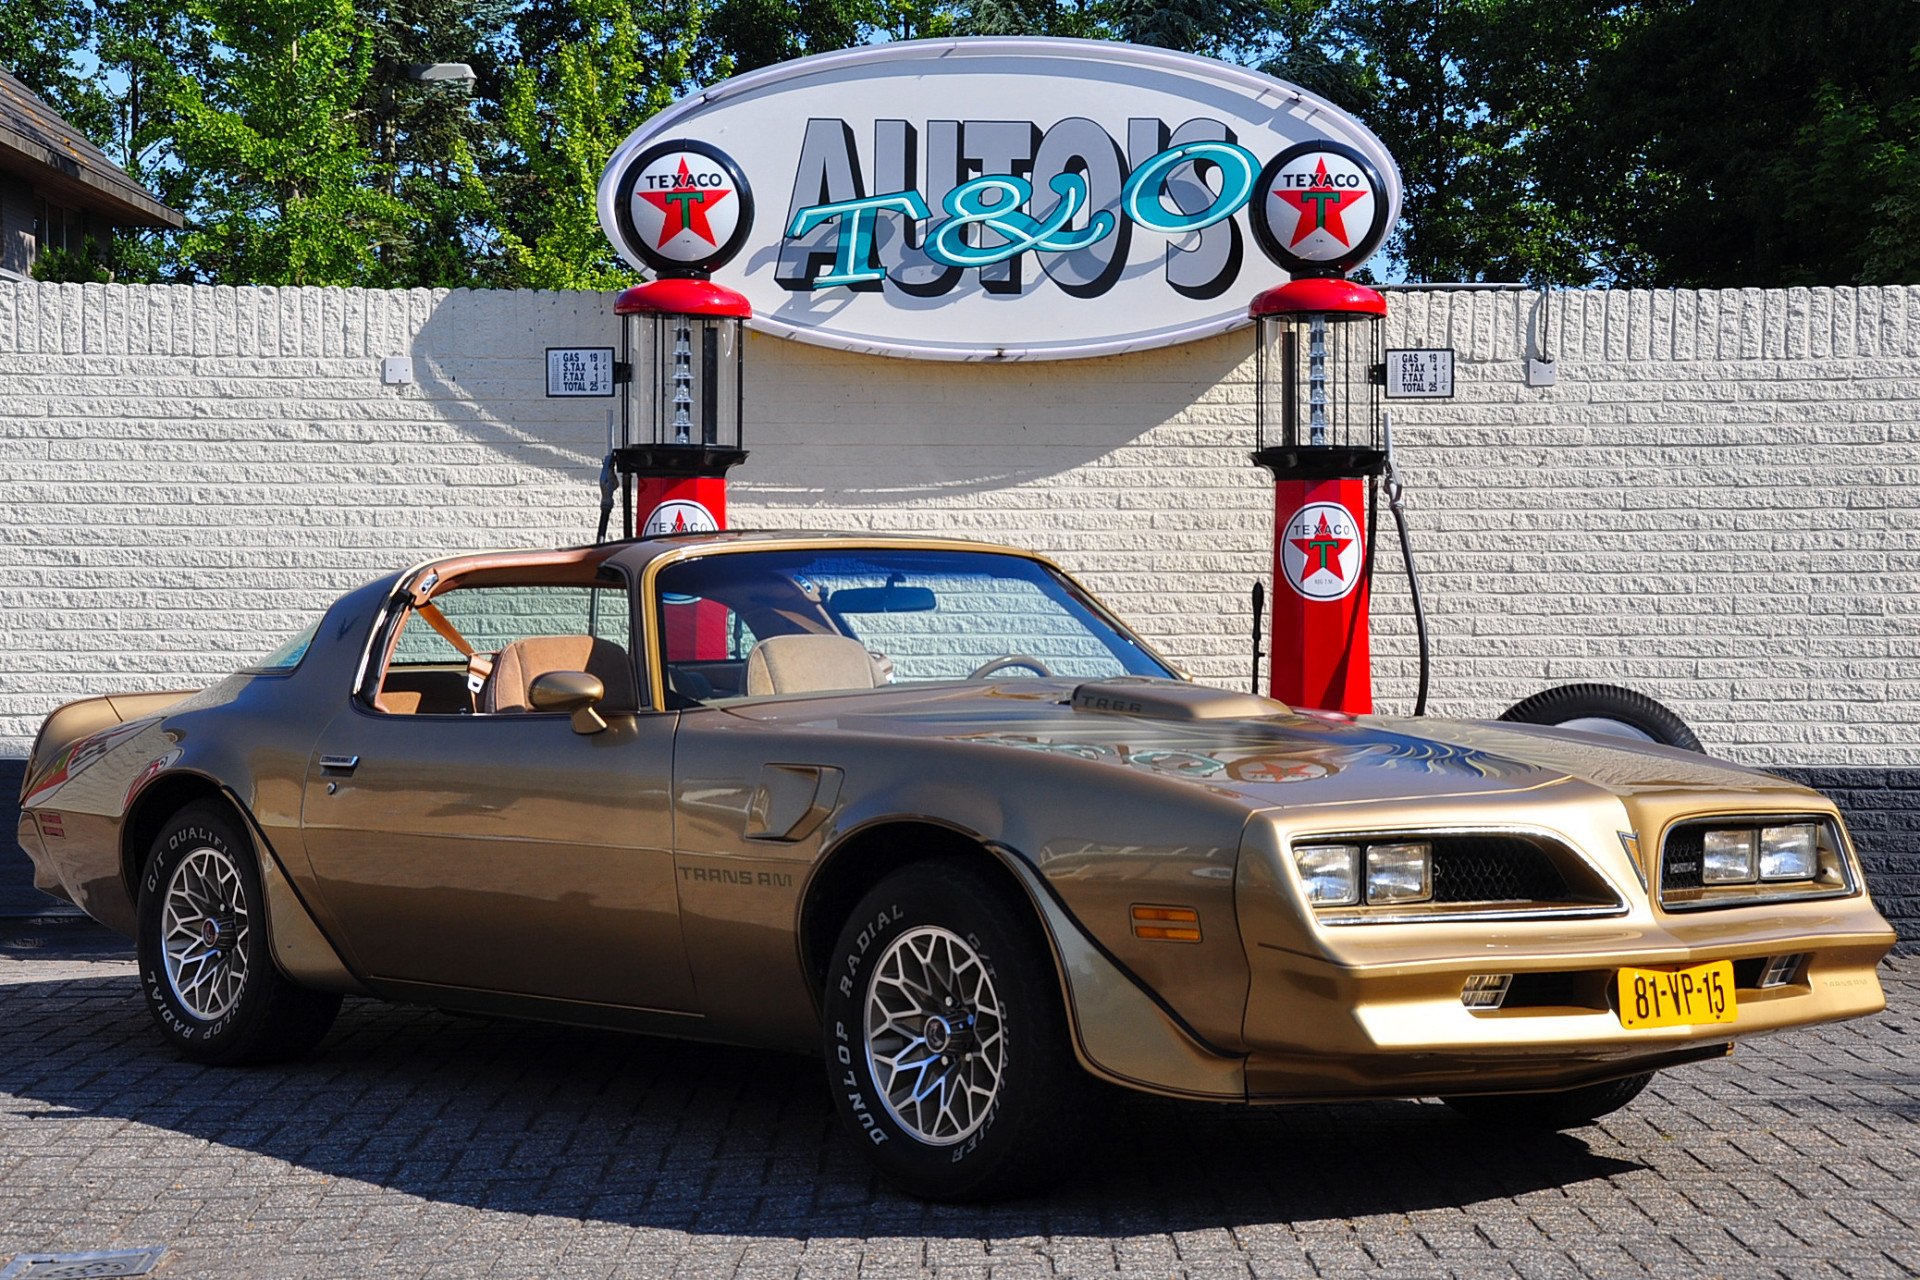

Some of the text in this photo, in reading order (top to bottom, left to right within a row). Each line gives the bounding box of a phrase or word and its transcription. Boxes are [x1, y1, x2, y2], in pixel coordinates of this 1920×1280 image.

[645, 173, 722, 189] TEXACO
[1283, 173, 1360, 188] TEXACO
[774, 117, 1244, 300] AUTO'S
[563, 352, 598, 362] GAS 19
[1402, 353, 1437, 363] GAS 19
[563, 362, 599, 372] S.TAX 4
[1402, 363, 1438, 373] S.TAX 4
[563, 372, 585, 382] F.TAX
[1402, 373, 1424, 383] F.TAX
[563, 381, 599, 391] TOTAL 25
[1402, 382, 1438, 392] TOTAL 25
[652, 522, 708, 533] TEXACO
[1294, 524, 1350, 536] TEXACO
[147, 852, 164, 893] G/T
[679, 866, 793, 887] TRANS AM
[839, 905, 904, 998] RADIAL
[1634, 971, 1725, 1019] 81-VP-15
[148, 971, 194, 1039] RADIAL
[836, 1021, 889, 1145] DUNLOP
